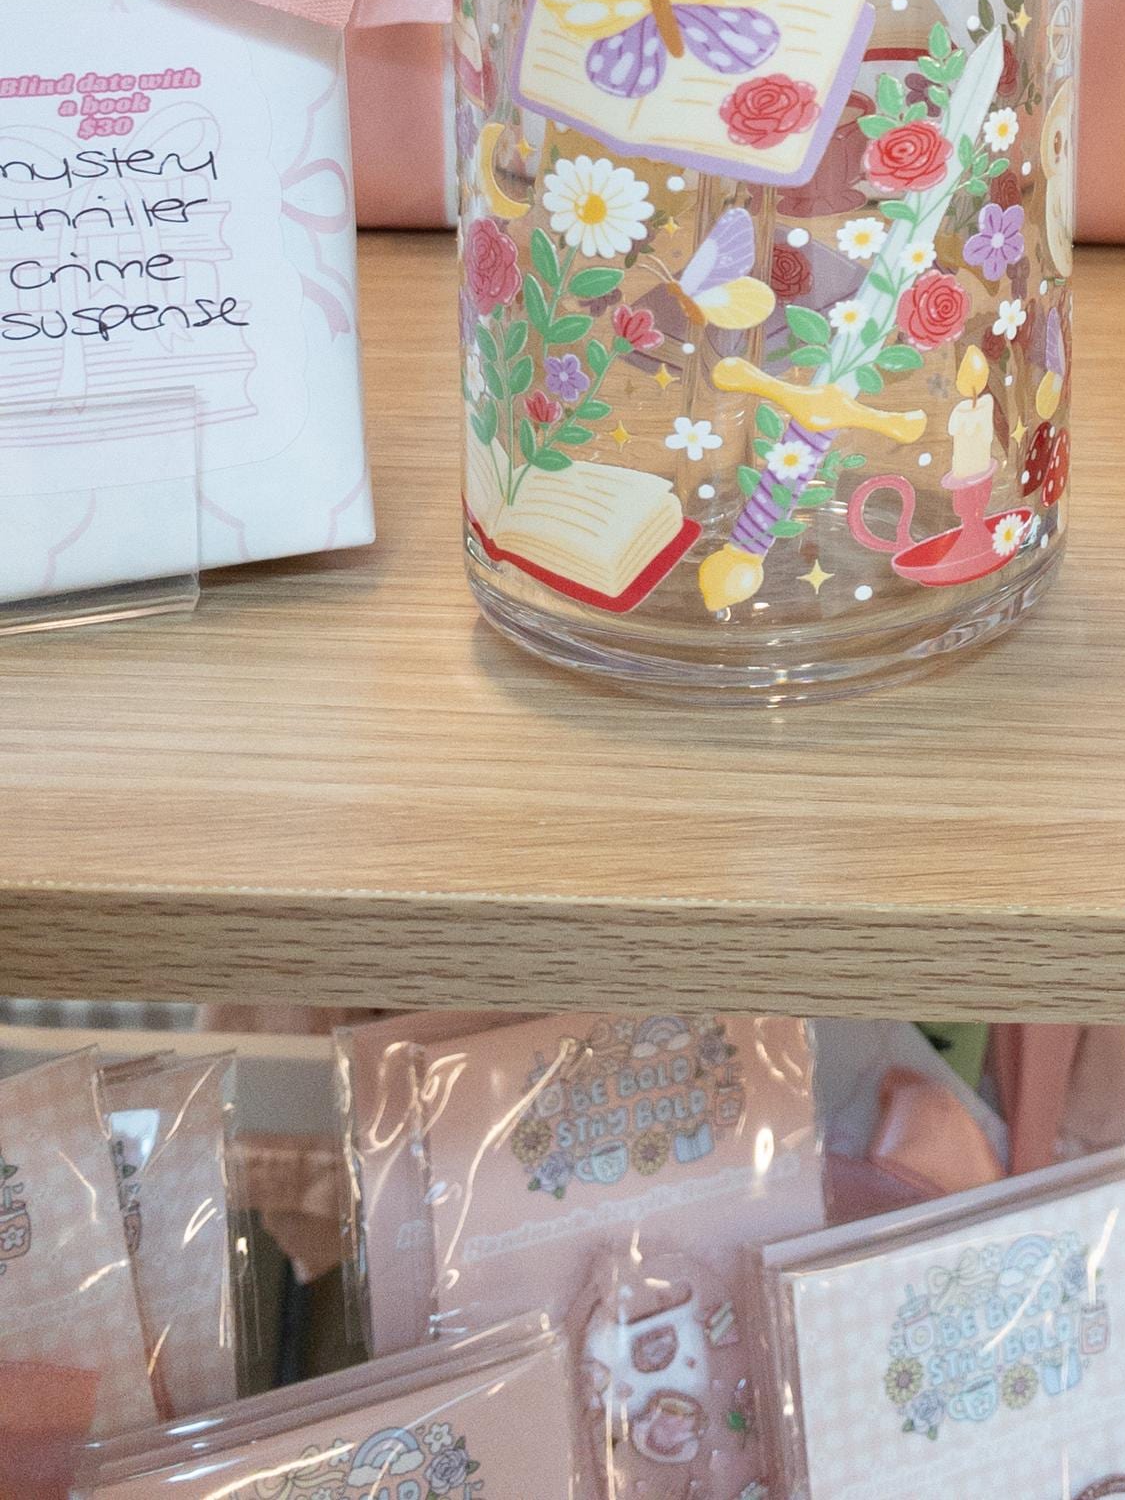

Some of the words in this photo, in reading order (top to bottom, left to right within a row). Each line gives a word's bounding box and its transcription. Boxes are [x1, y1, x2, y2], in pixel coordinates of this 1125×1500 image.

[0, 73, 75, 98] Blind
[76, 72, 136, 93] date
[138, 67, 201, 90] with
[58, 100, 78, 117] a
[80, 92, 151, 116] book
[77, 115, 134, 140] $30
[9, 252, 185, 290] crime
[1, 297, 250, 341] suspense
[570, 1076, 607, 1112] BE
[617, 1056, 690, 1098] BOLD
[634, 1089, 707, 1130] BOLD
